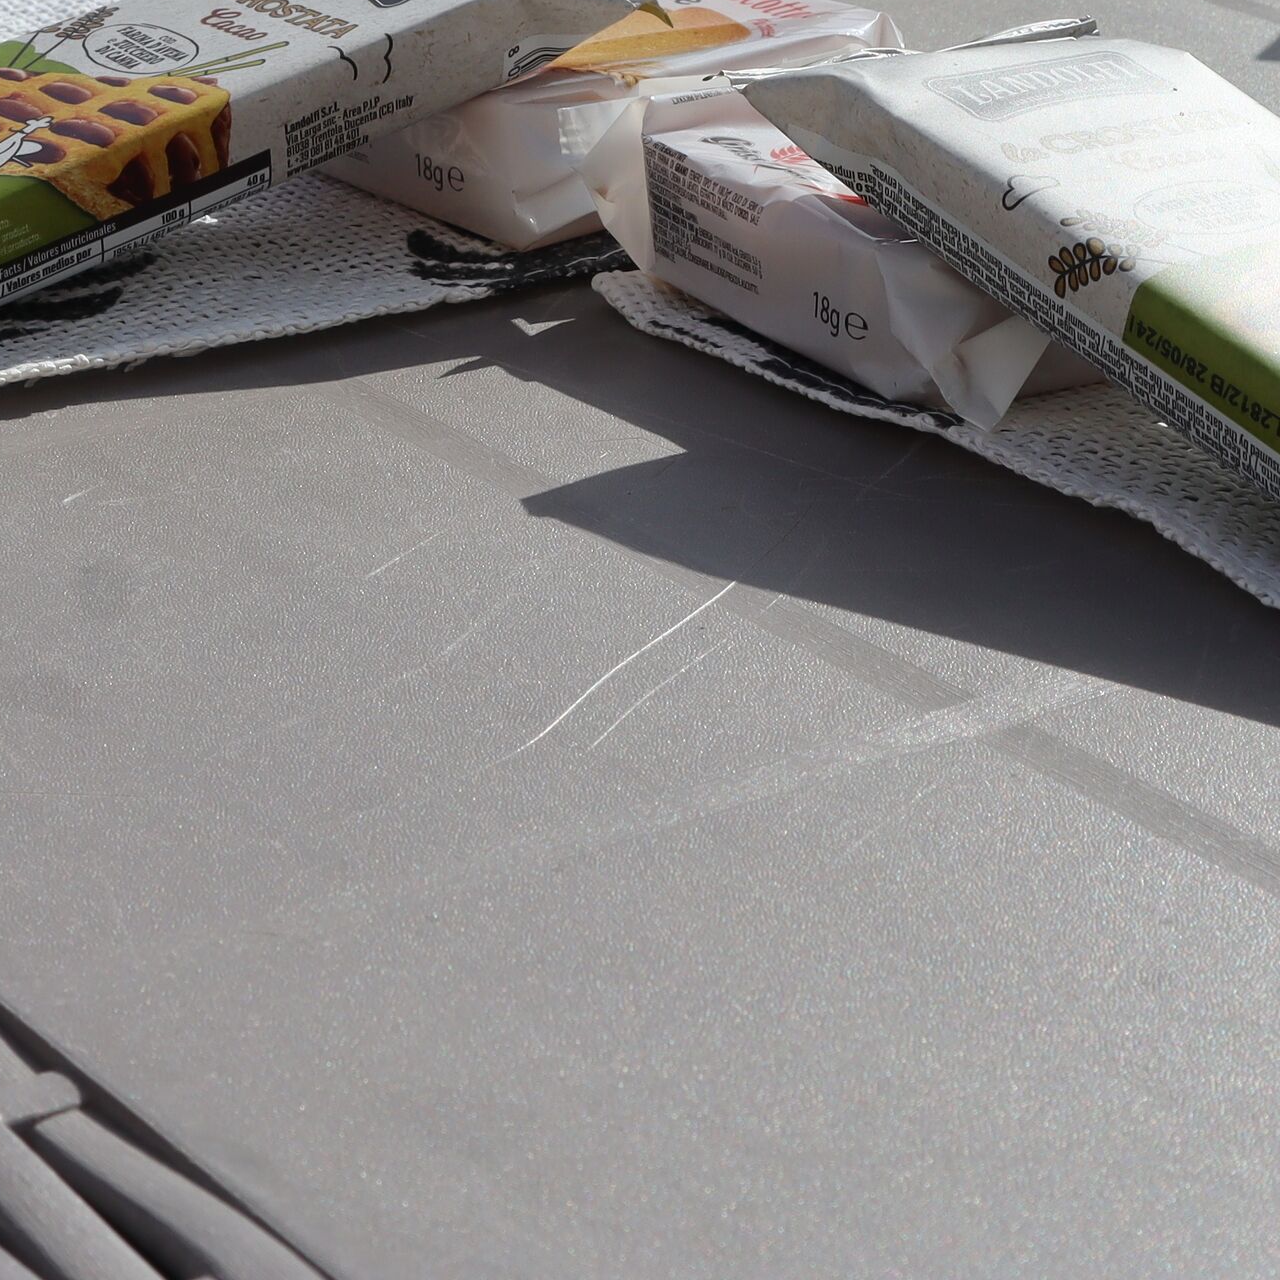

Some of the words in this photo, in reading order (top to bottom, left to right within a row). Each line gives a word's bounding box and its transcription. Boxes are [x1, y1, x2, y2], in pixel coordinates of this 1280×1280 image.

[117, 26, 155, 46] FARINA
[200, 7, 270, 41] Cacao
[105, 51, 141, 69] CANNA
[952, 59, 1137, 106] LANDOLFI
[284, 108, 320, 134] Landolfi
[286, 132, 299, 146] Via
[300, 123, 321, 140] Larga
[322, 116, 337, 129] snc
[343, 106, 362, 121] Area
[286, 140, 309, 158] 81038
[311, 122, 343, 146] Trentola
[344, 110, 377, 130] Ducenta
[379, 101, 395, 119] (CE)
[395, 94, 414, 111] Italy
[415, 153, 444, 192] 18g
[162, 210, 177, 224] 100
[179, 209, 184, 218] g
[0, 264, 21, 279] Facts
[28, 247, 59, 265] Valores
[61, 223, 115, 252] nutricionales
[7, 271, 40, 291] Valores
[42, 256, 75, 276] medios
[77, 248, 93, 264] por
[813, 291, 840, 337] 18g
[1066, 311, 1100, 344] Consumir
[1107, 340, 1148, 377] packaging.
[1137, 322, 1206, 382] 28/05/24
[1149, 371, 1161, 388] the
[1165, 383, 1174, 395] on
[1175, 390, 1204, 417] printed
[1205, 412, 1222, 431] date
[1224, 425, 1236, 442] the
[1239, 434, 1248, 449] by
